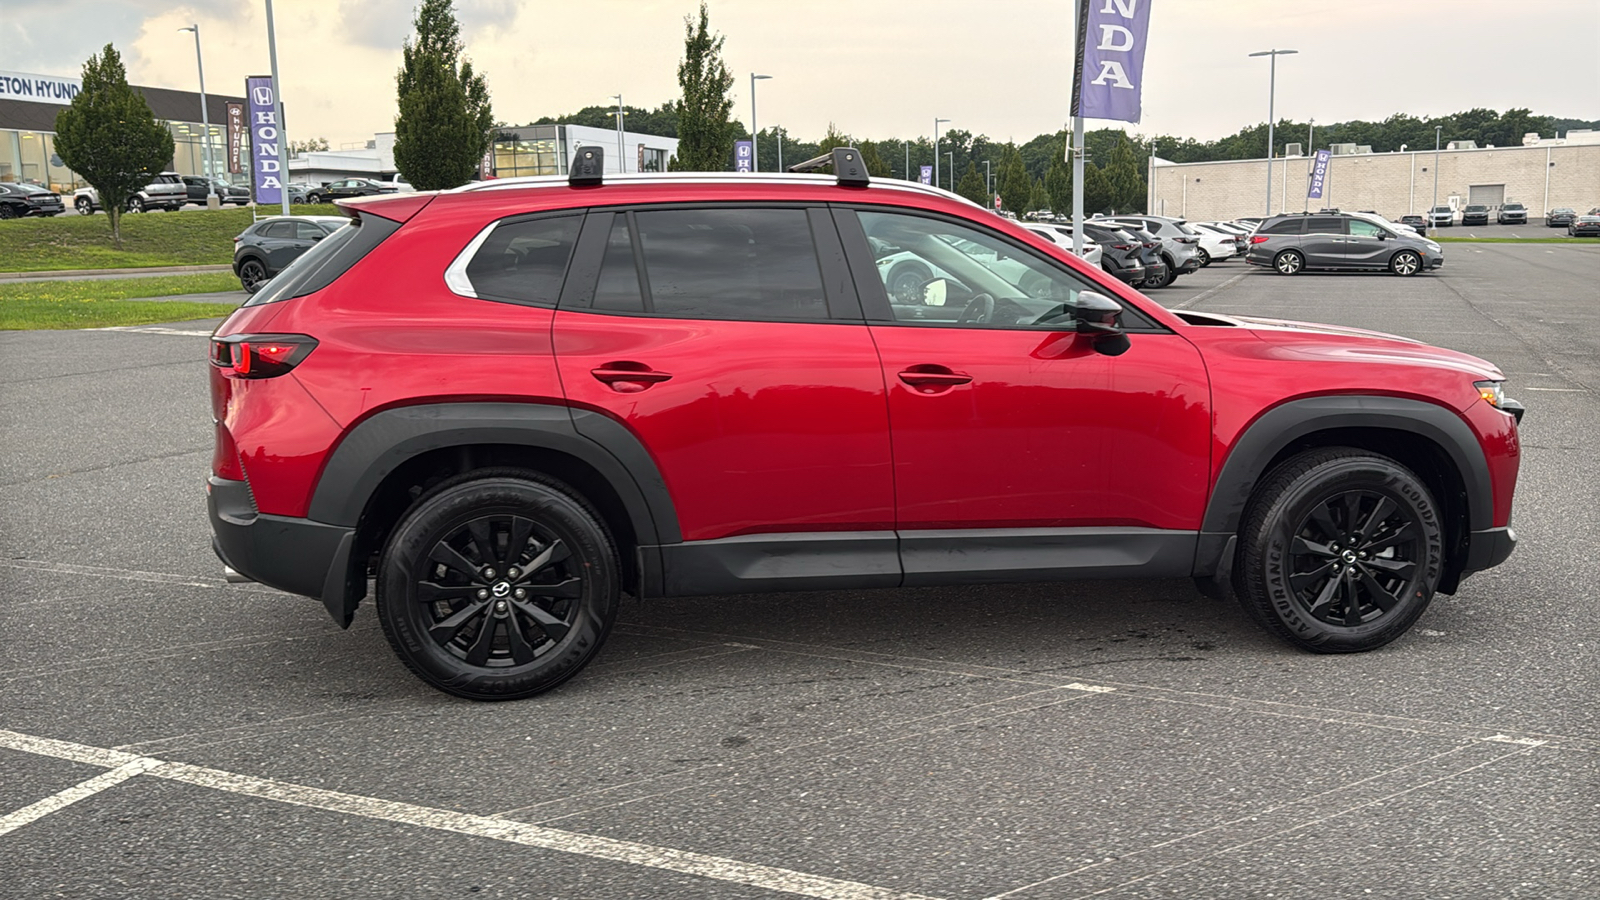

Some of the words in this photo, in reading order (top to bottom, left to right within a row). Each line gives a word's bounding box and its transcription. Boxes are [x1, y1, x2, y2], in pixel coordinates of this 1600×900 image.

[35, 80, 83, 99] HYUND
[256, 112, 282, 188] HONDA
[1312, 163, 1326, 193] HONDA
[1402, 484, 1442, 579] GOODYEAR
[1268, 540, 1311, 633] ASSURANCE
